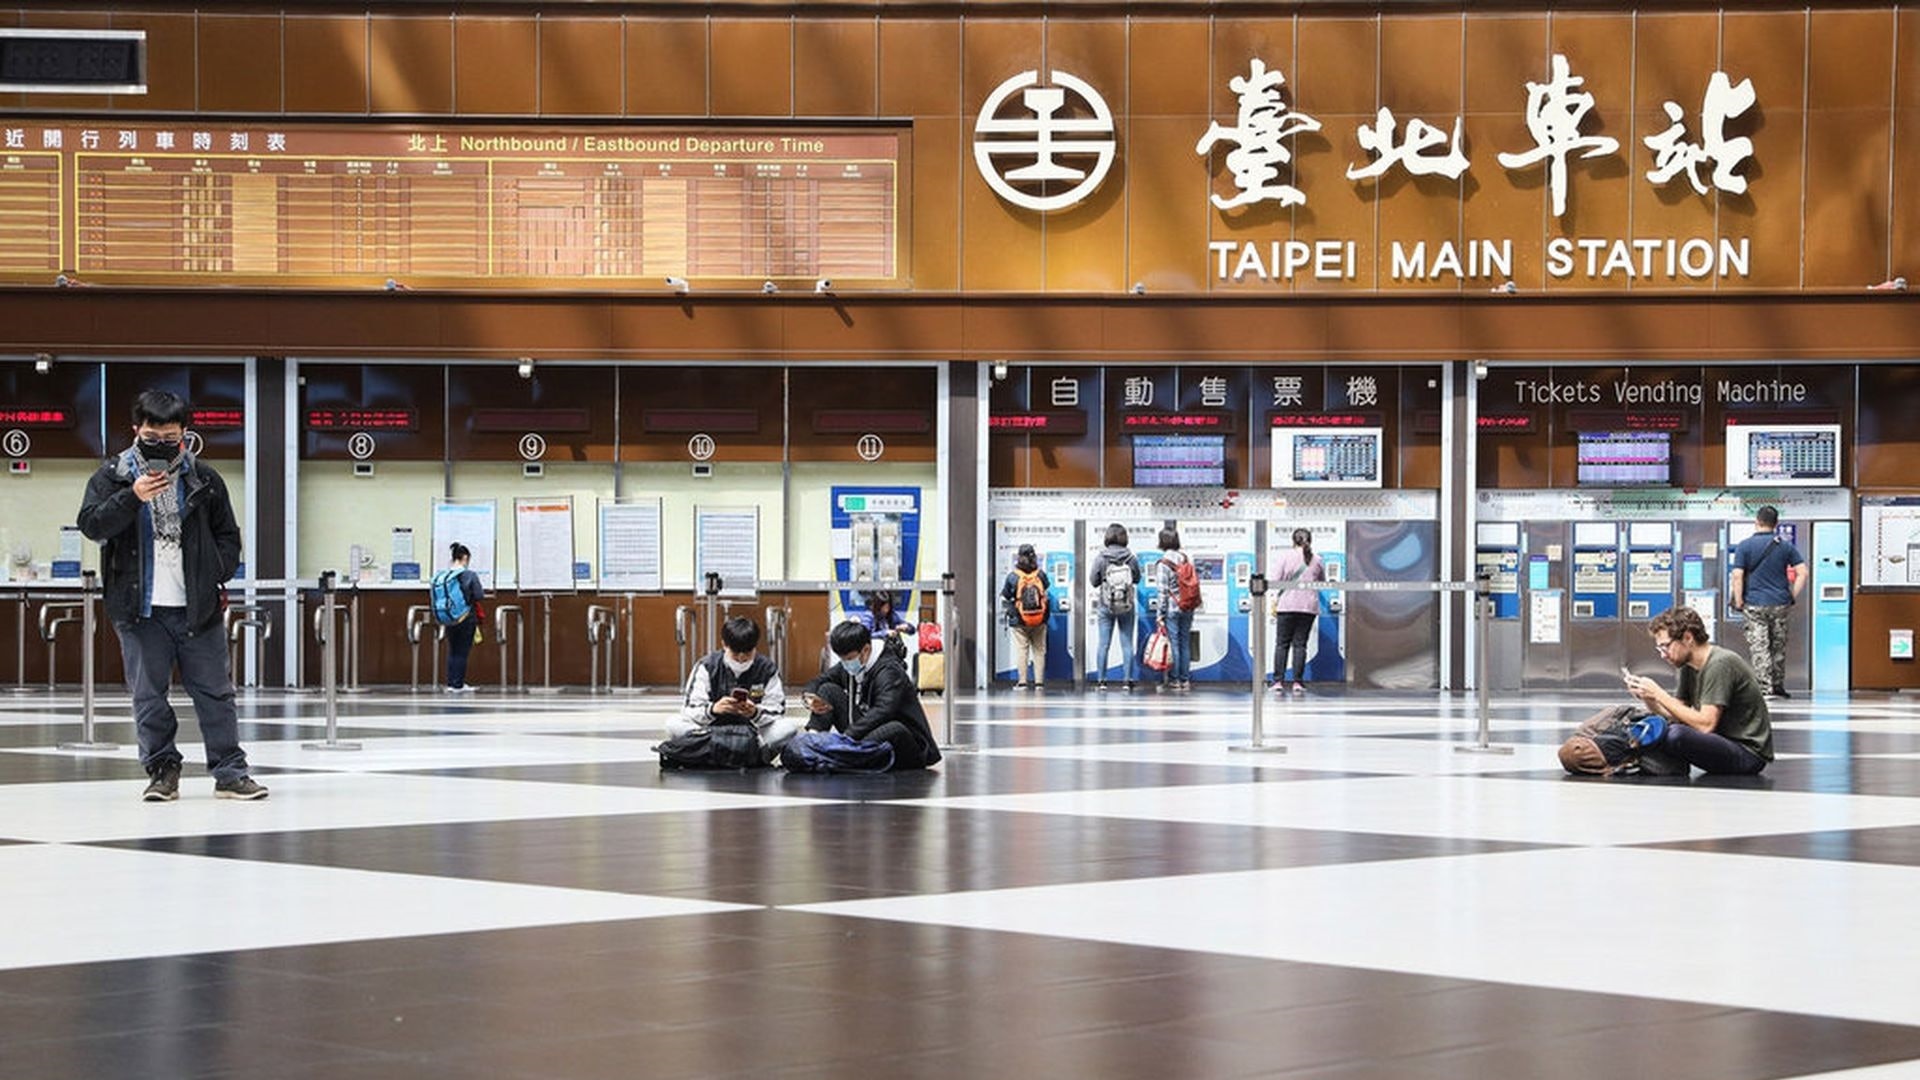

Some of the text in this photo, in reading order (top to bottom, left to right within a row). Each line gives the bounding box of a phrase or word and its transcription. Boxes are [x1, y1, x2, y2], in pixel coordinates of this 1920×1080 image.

[5, 128, 286, 152] 近開行列車時刻表
[407, 134, 448, 153] 北上
[460, 136, 567, 153] Northbound
[584, 137, 680, 154] Eastbound
[686, 138, 775, 157] Departure
[780, 138, 824, 153] Time
[1196, 54, 1756, 217] 臺北車站
[1209, 238, 1751, 280] TAIPEI MAIN STATION
[1051, 375, 1378, 408] 自動售票機
[1515, 380, 1806, 405] Tickets Vending Machine
